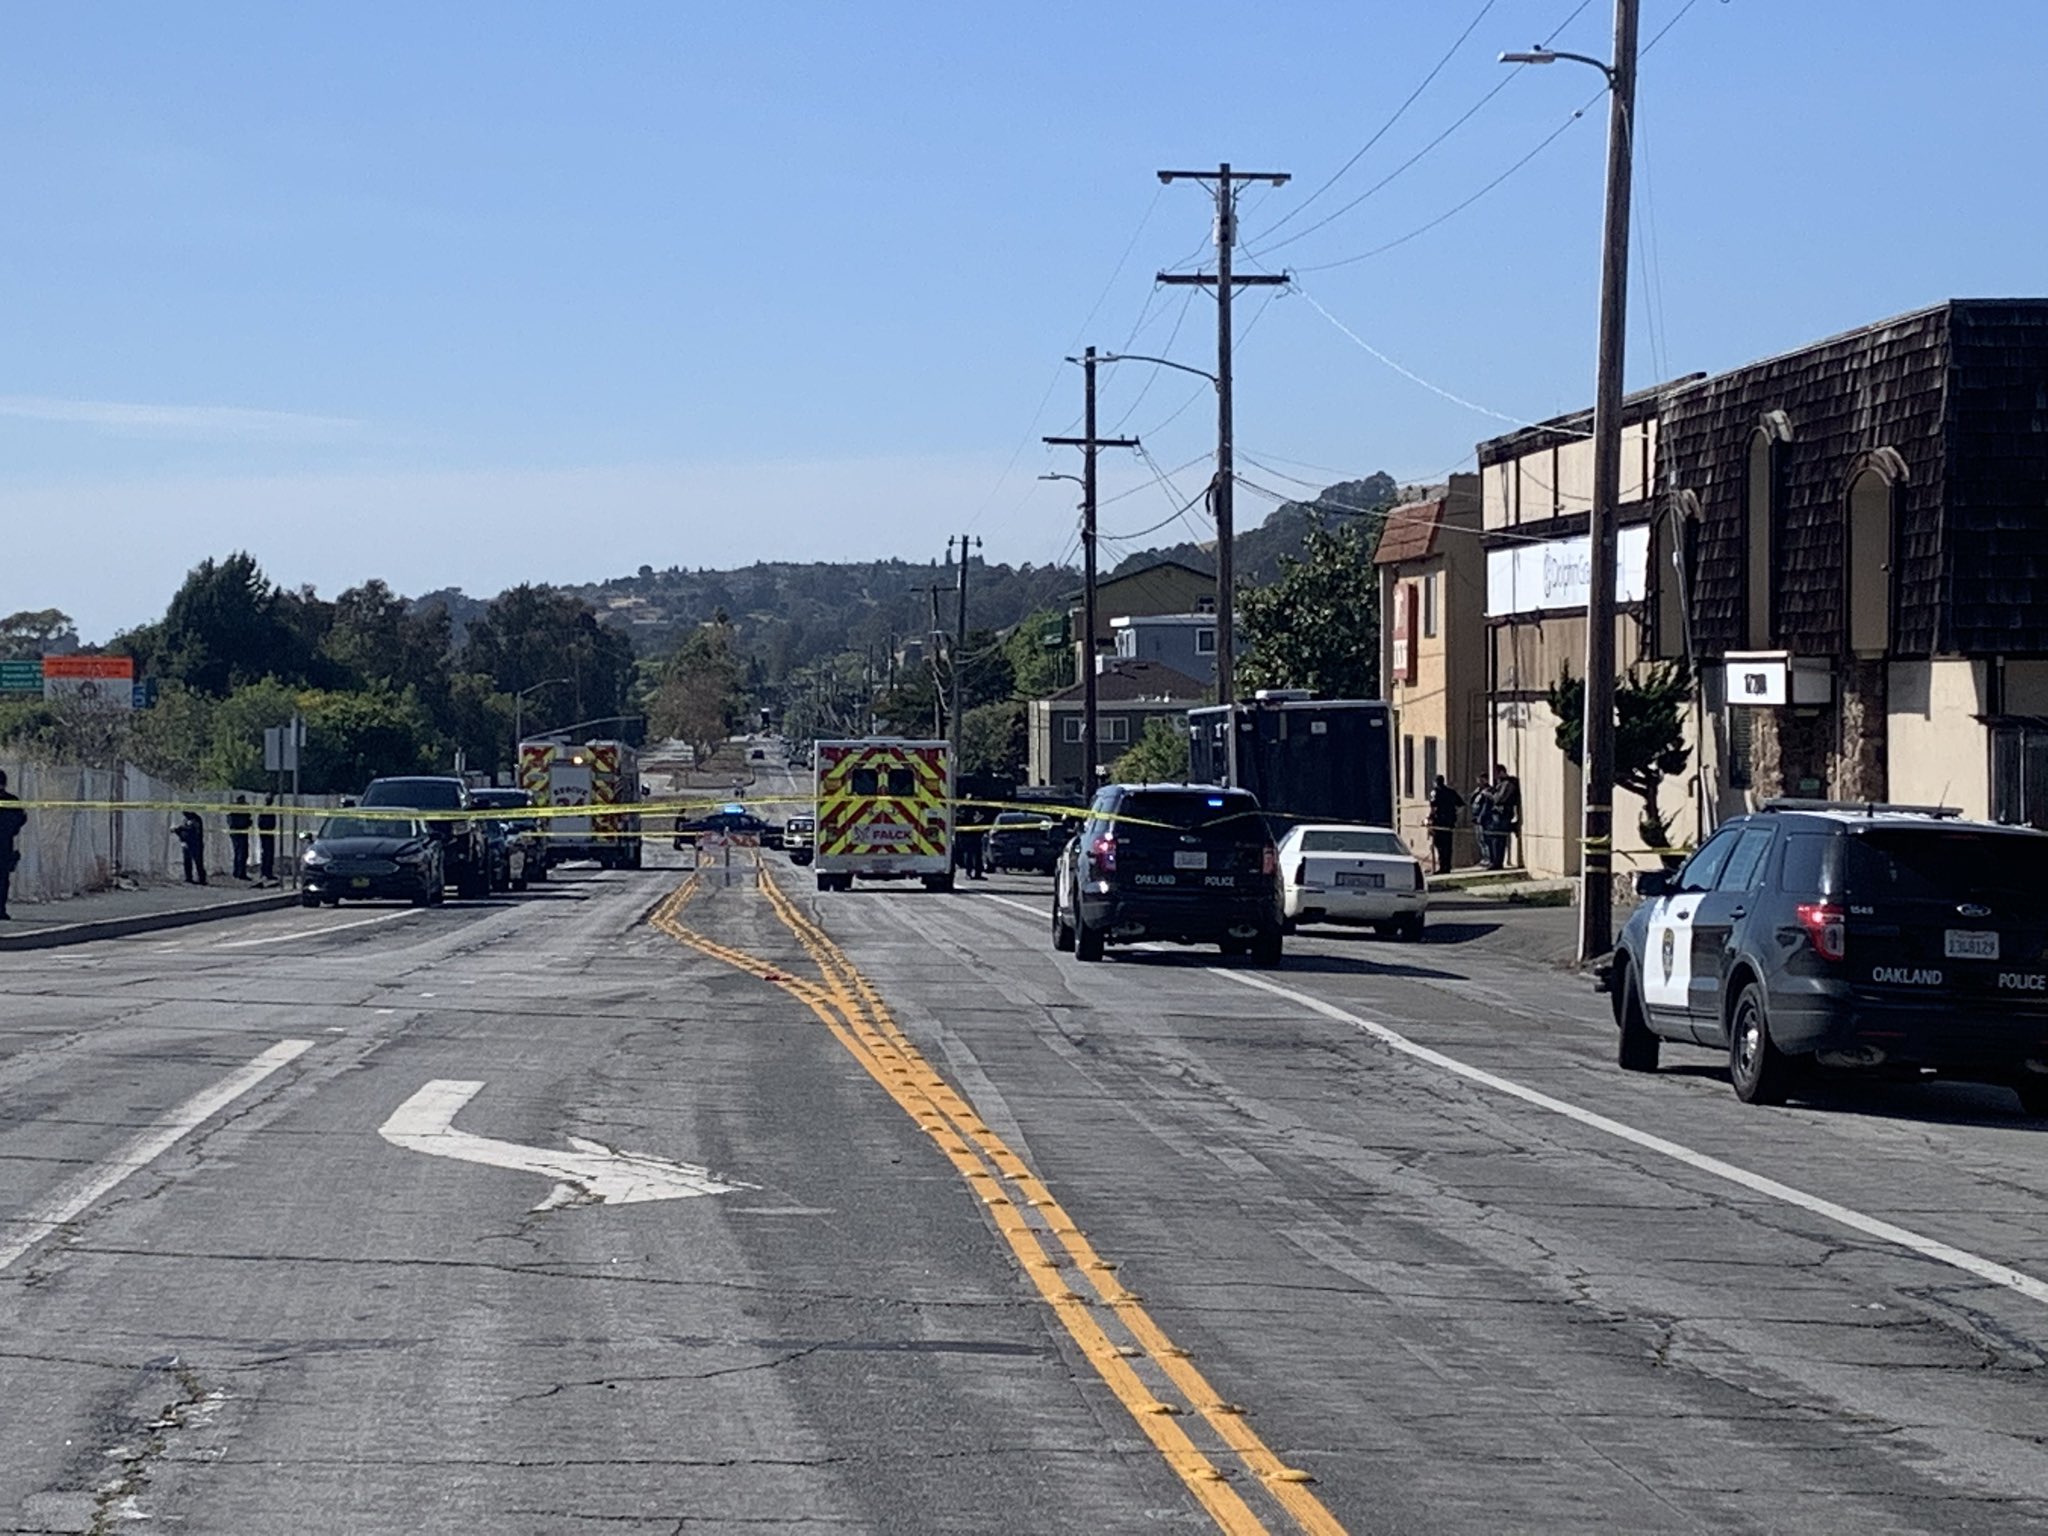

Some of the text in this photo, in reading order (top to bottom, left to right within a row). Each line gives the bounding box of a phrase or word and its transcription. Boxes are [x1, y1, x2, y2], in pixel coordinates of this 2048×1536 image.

[872, 829, 912, 840] FALCK
[1134, 874, 1235, 887] OAKLAND POLICE
[1872, 966, 2047, 990] OAKLAND POLICE
